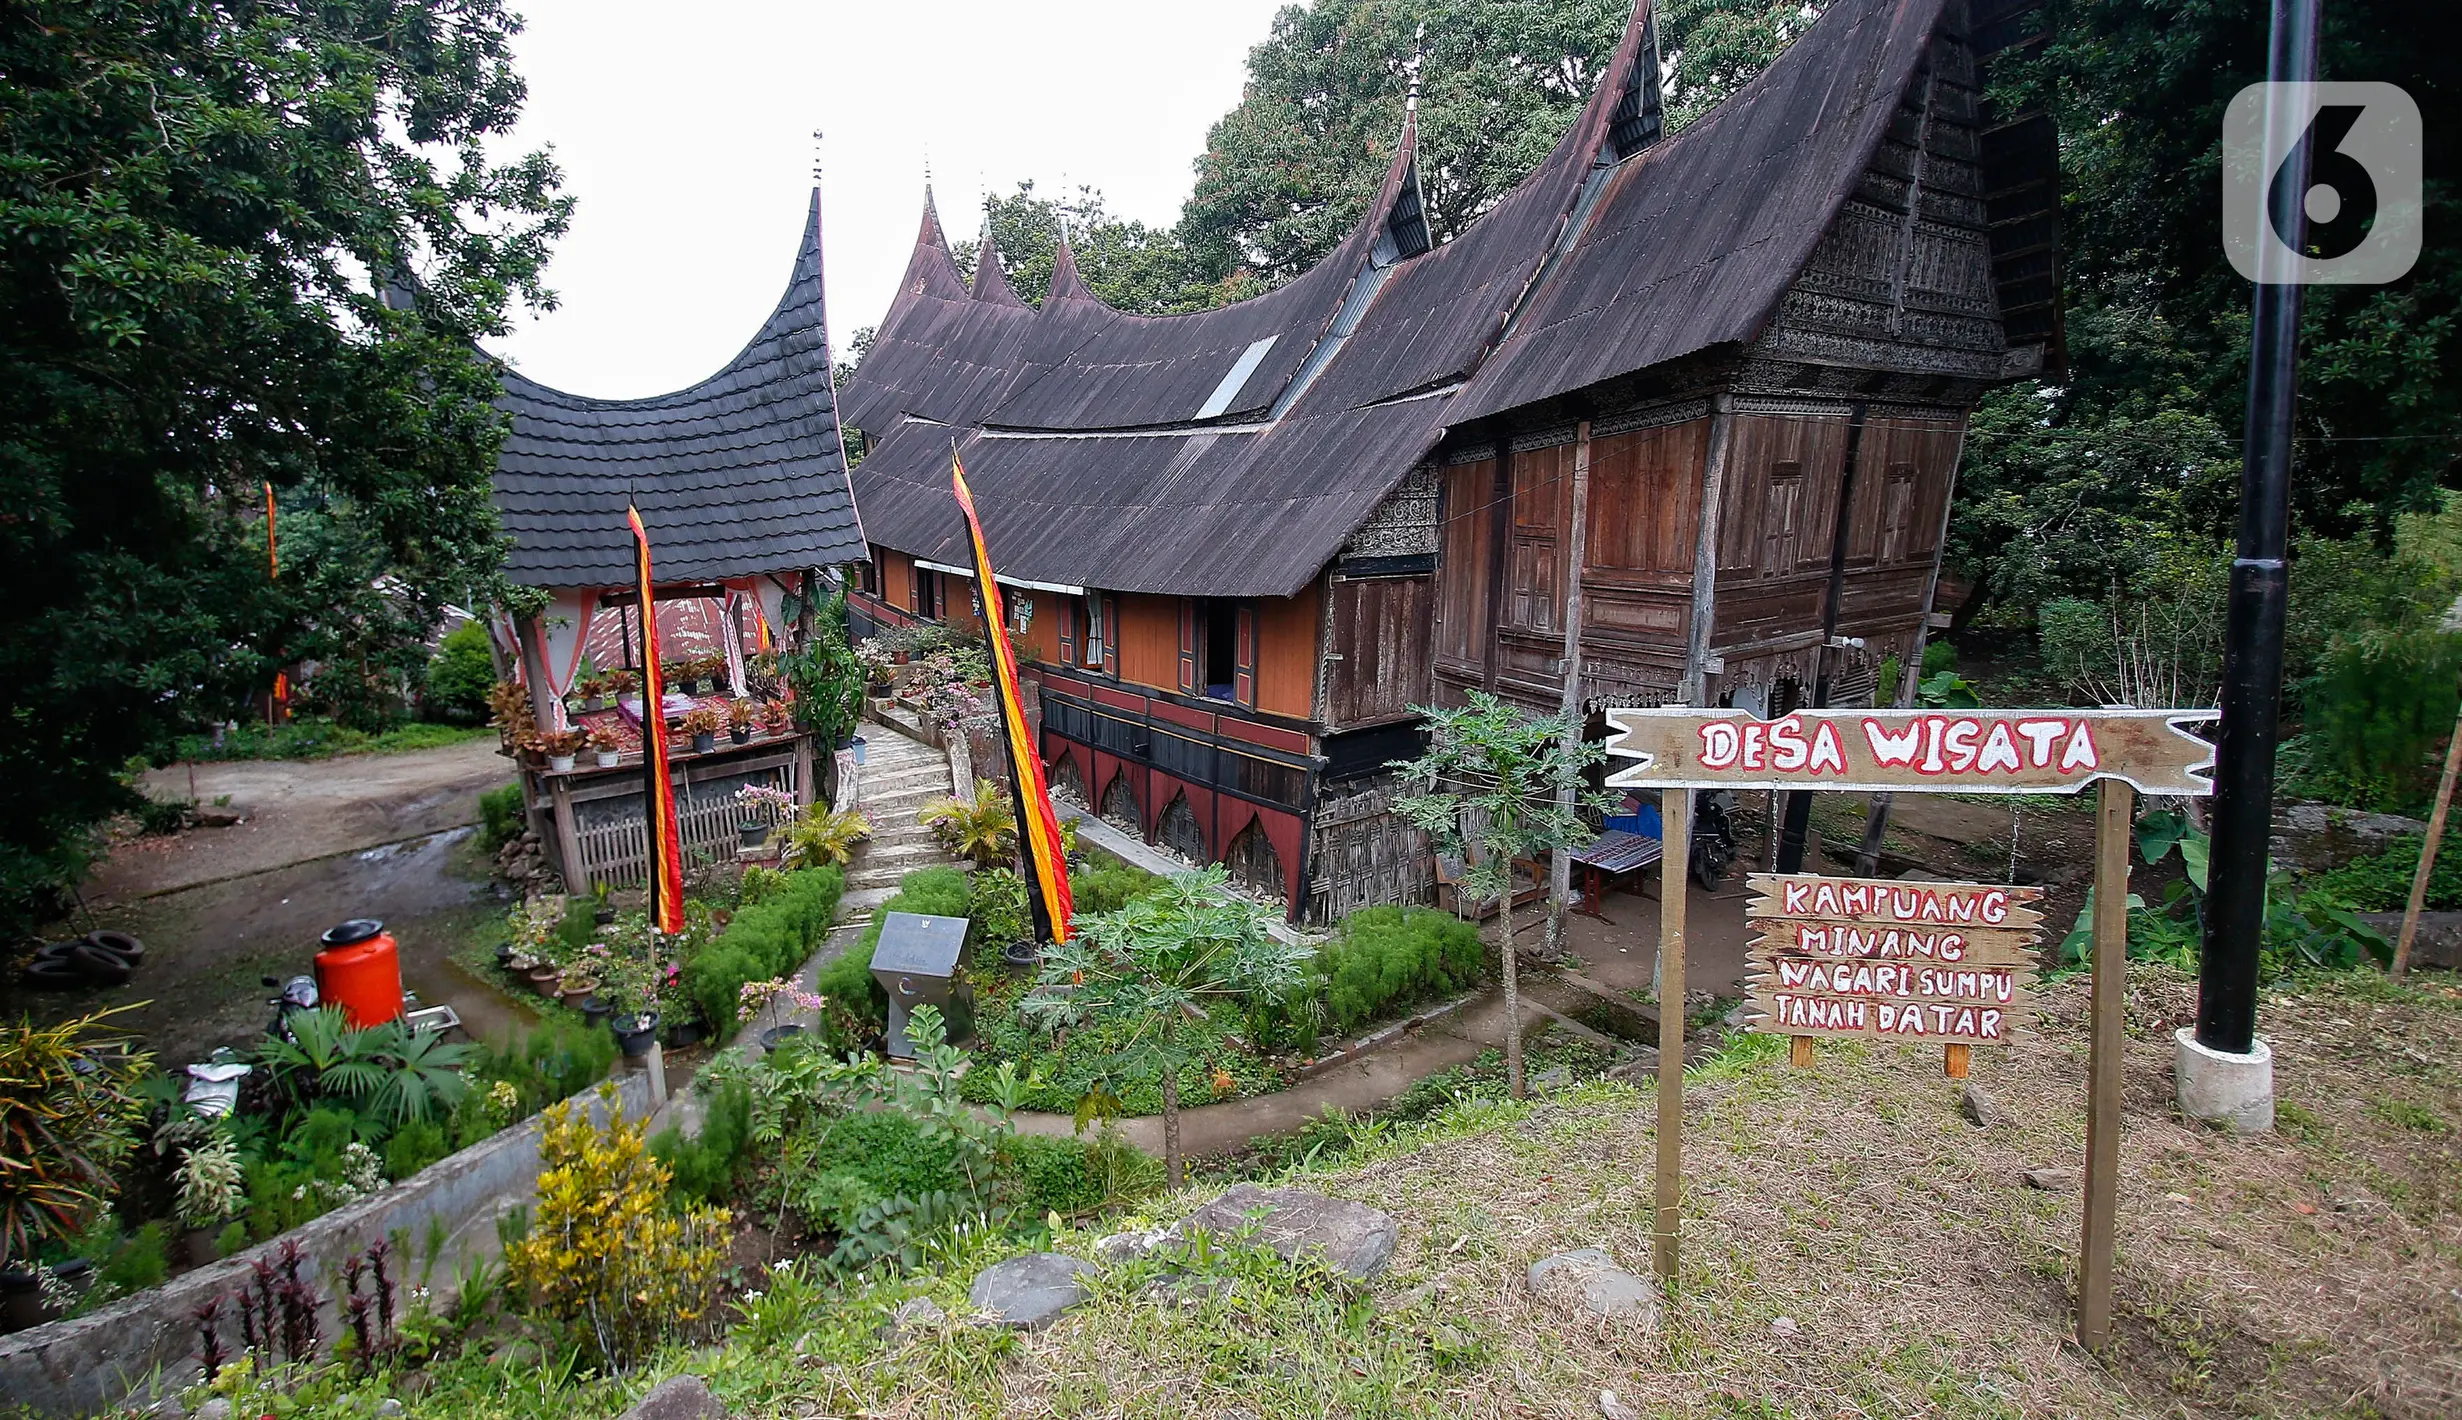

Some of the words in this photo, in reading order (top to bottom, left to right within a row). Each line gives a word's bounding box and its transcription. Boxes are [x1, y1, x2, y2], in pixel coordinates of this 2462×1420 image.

[1697, 714, 1848, 776] DESA
[1860, 715, 2100, 776] WISATA
[1783, 880, 2009, 925] KAMPUANG
[1797, 924, 1965, 963] MINANG
[1776, 957, 1914, 998] NAGARI
[1919, 968, 2012, 1003] SUMPU
[1773, 993, 1866, 1031] TANAH
[1876, 1002, 2000, 1040] DATAR
